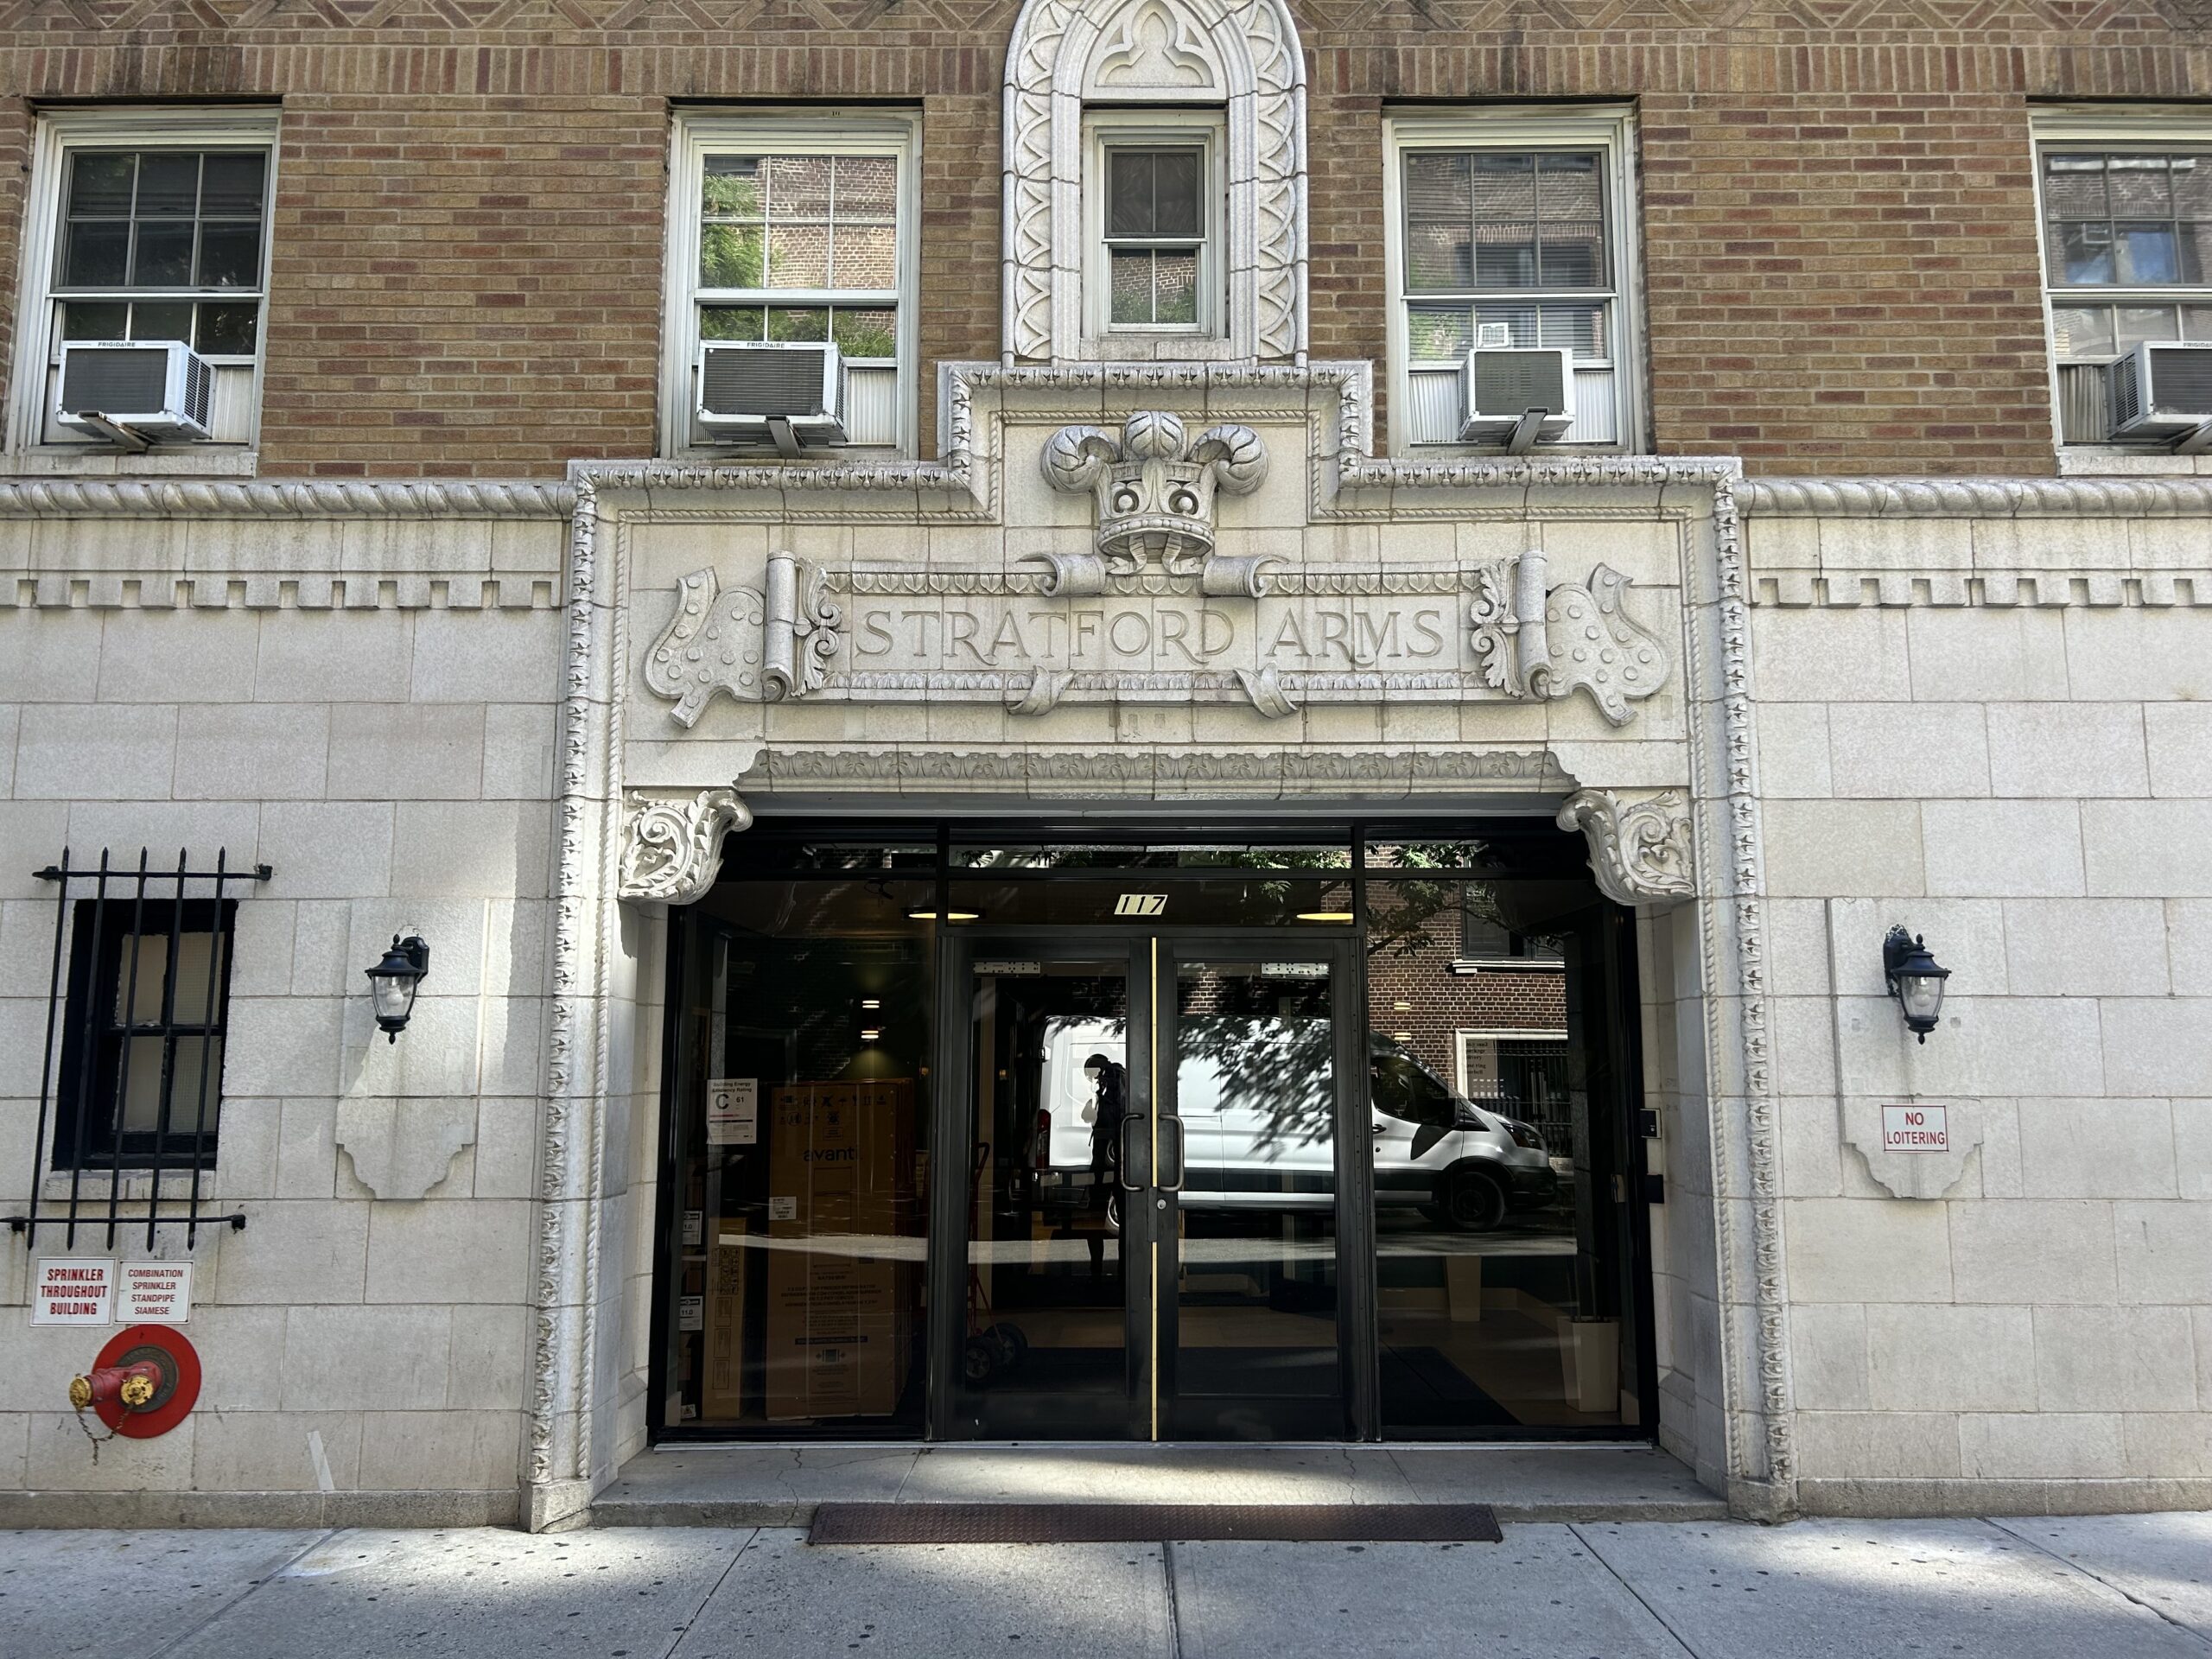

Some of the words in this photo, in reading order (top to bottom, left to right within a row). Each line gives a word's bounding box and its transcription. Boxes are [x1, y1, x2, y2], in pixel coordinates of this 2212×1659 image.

[854, 607, 1236, 665] STRATFORD
[1265, 608, 1444, 667] ARMS
[1121, 895, 1166, 913] 117
[715, 1093, 729, 1109] C
[1905, 1112, 1924, 1126] NO
[1886, 1131, 1946, 1145] LOITERING
[47, 1268, 104, 1281] SPRINKLER
[128, 1268, 183, 1278] COMBINATION
[41, 1285, 108, 1298] THROUGHOUT
[132, 1281, 176, 1290] SPRINKLER
[130, 1294, 175, 1303] STANDPIPE
[49, 1302, 98, 1315] BUILDING
[134, 1306, 170, 1315] SIAMESE
